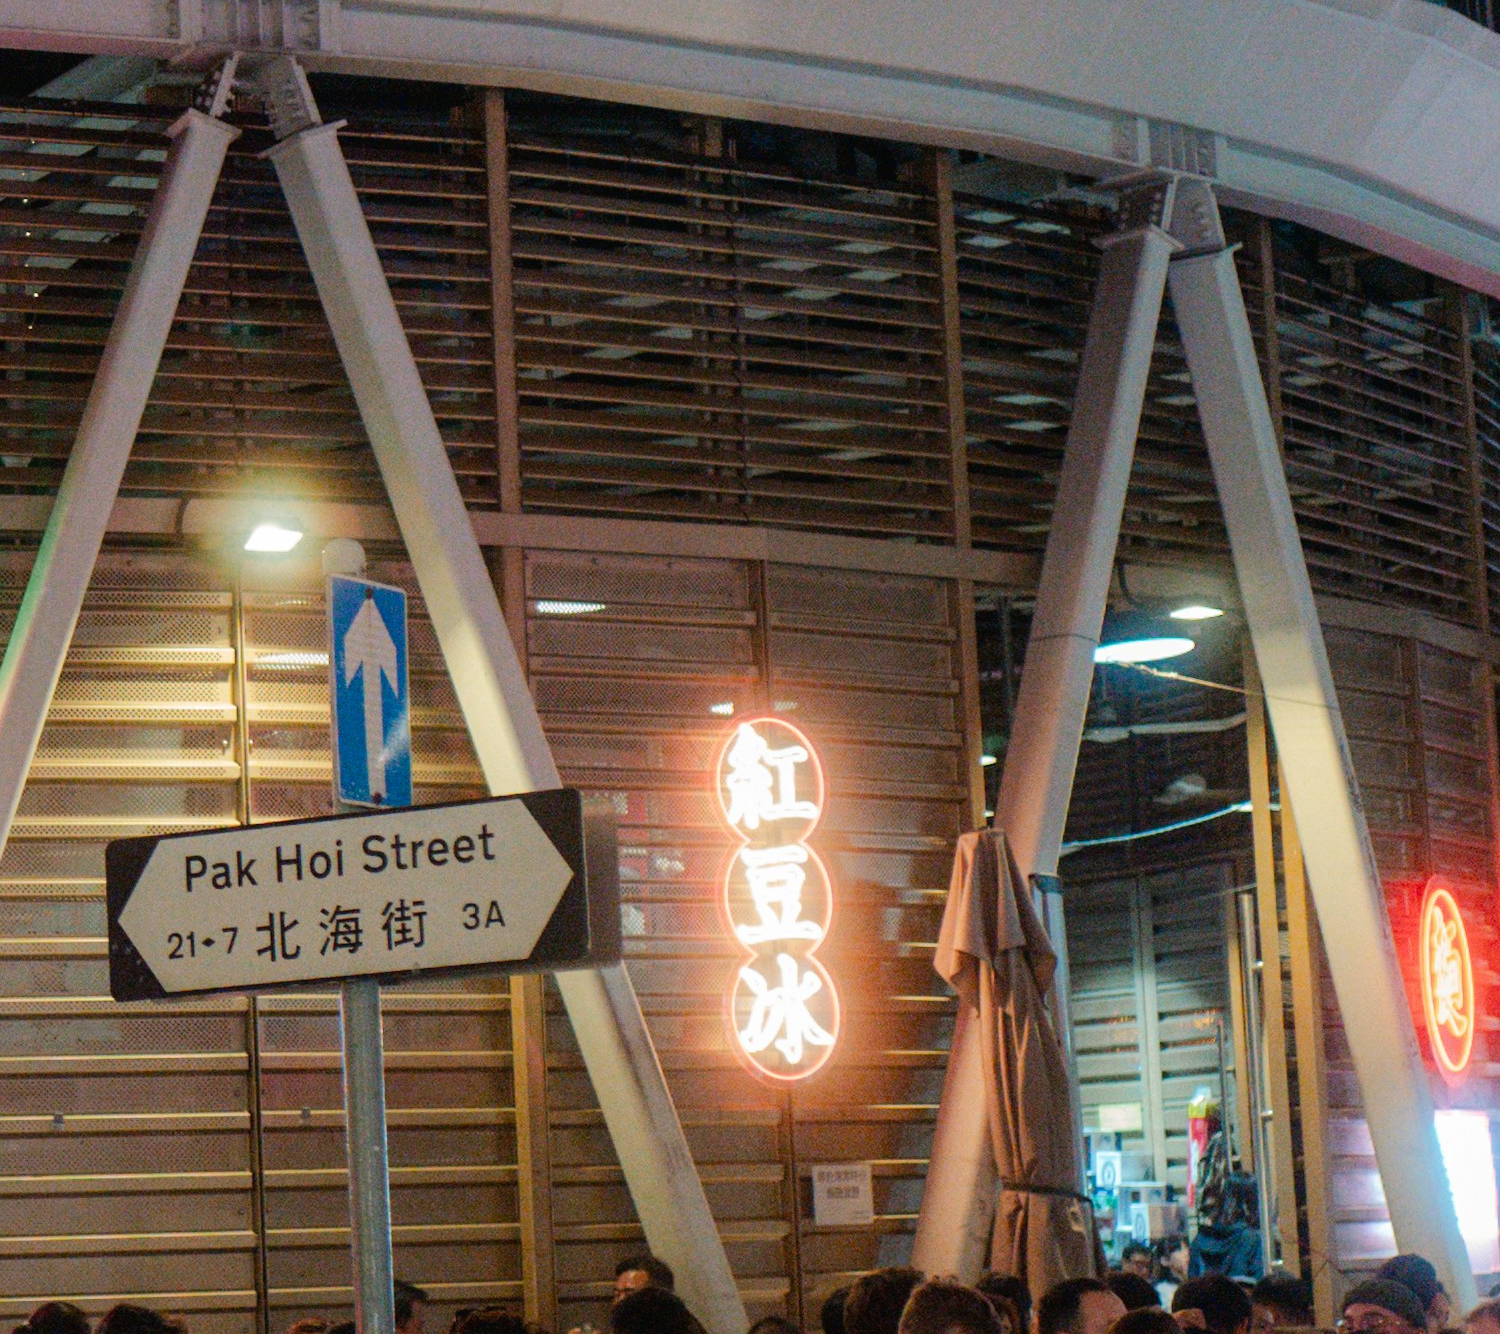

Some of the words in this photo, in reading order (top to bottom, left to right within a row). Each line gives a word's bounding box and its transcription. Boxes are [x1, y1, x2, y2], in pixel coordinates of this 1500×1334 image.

[185, 850, 257, 892] Pak
[276, 840, 343, 882] Hoi
[362, 823, 496, 873] Street
[725, 722, 836, 1064] 紅豆冰
[256, 899, 428, 962] 北海街
[462, 900, 507, 931] 3A
